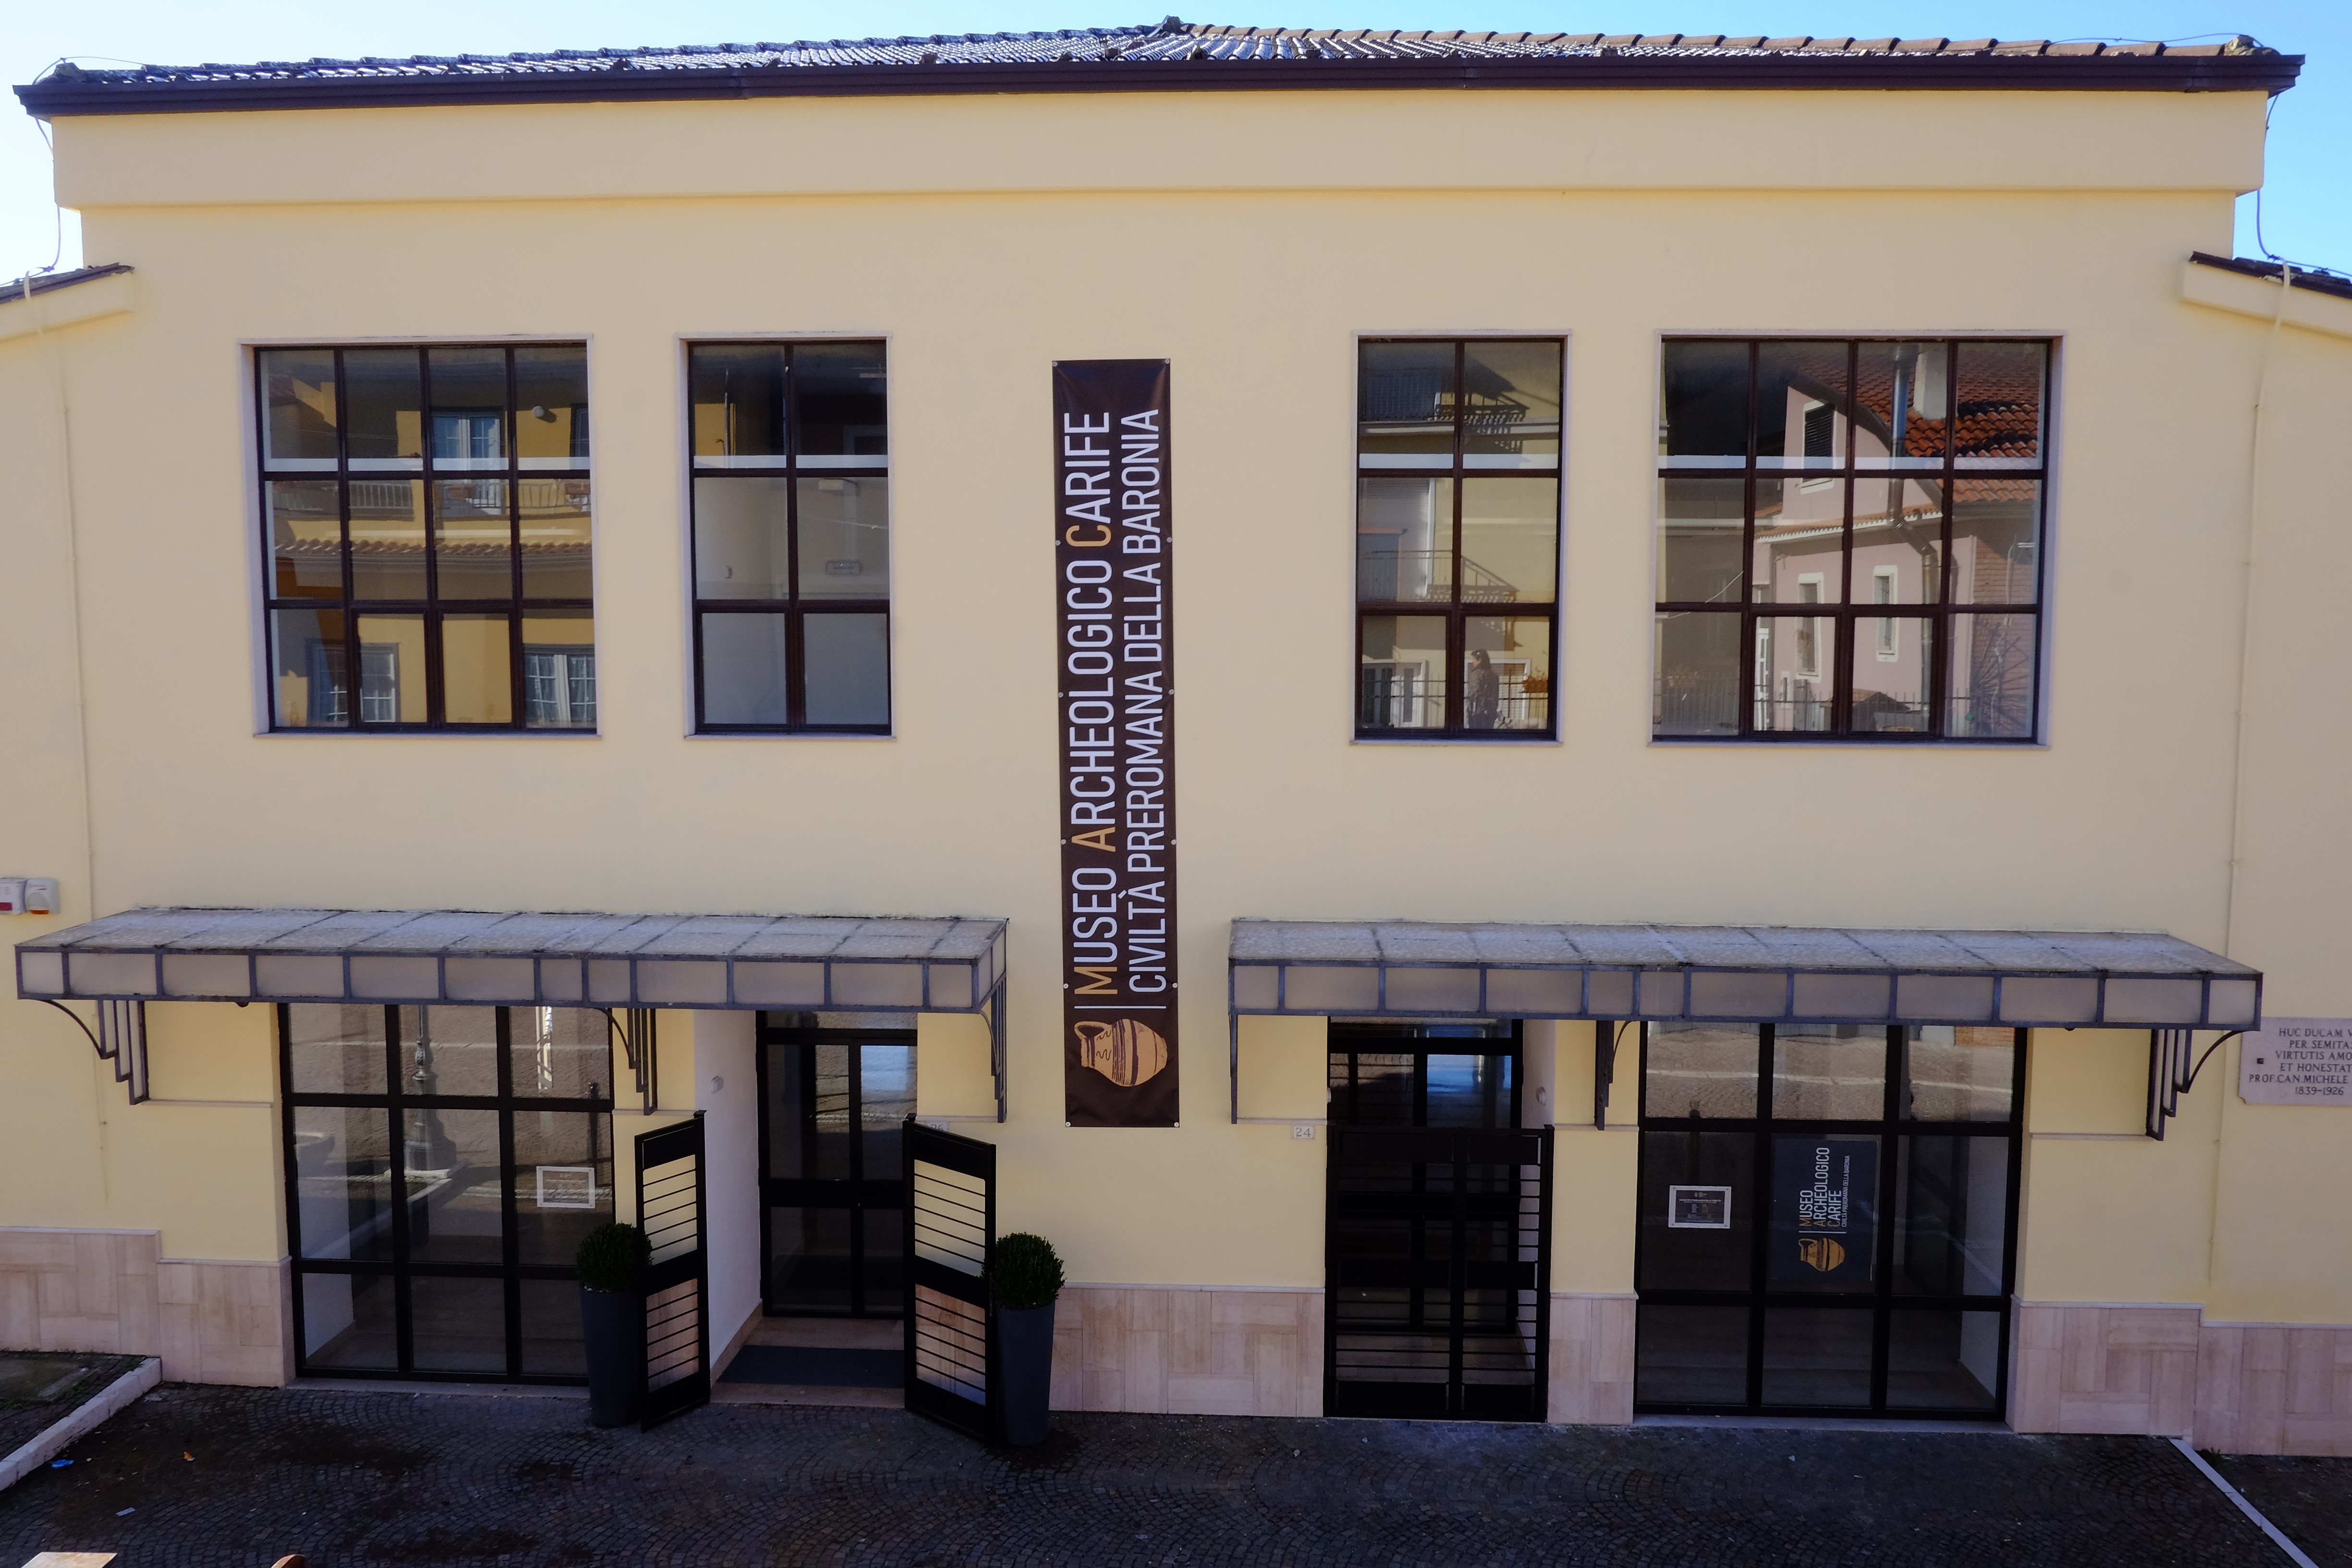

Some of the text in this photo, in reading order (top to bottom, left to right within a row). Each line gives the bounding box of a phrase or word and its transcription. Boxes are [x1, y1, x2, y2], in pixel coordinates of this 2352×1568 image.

[1064, 412, 1118, 994] MUSEO ARCHEOLOGICO CARIFE
[1118, 409, 1166, 992] CIVILTÀ PREROMANA DELLA BARONIA
[2278, 1028, 2300, 1037] HUC
[2304, 1029, 2342, 1037] DUCAM
[2289, 1040, 2307, 1048] PER
[2275, 1051, 2325, 1060] VIRTUTIS
[2280, 1063, 2293, 1071] ET
[2295, 1086, 2344, 1095] 1839-1926
[1296, 1127, 1311, 1137] 24
[1813, 1147, 1830, 1227] ARCHEOLOGICO
[1799, 1190, 1813, 1226] MUSEO
[1827, 1190, 1842, 1227] CARIFE
